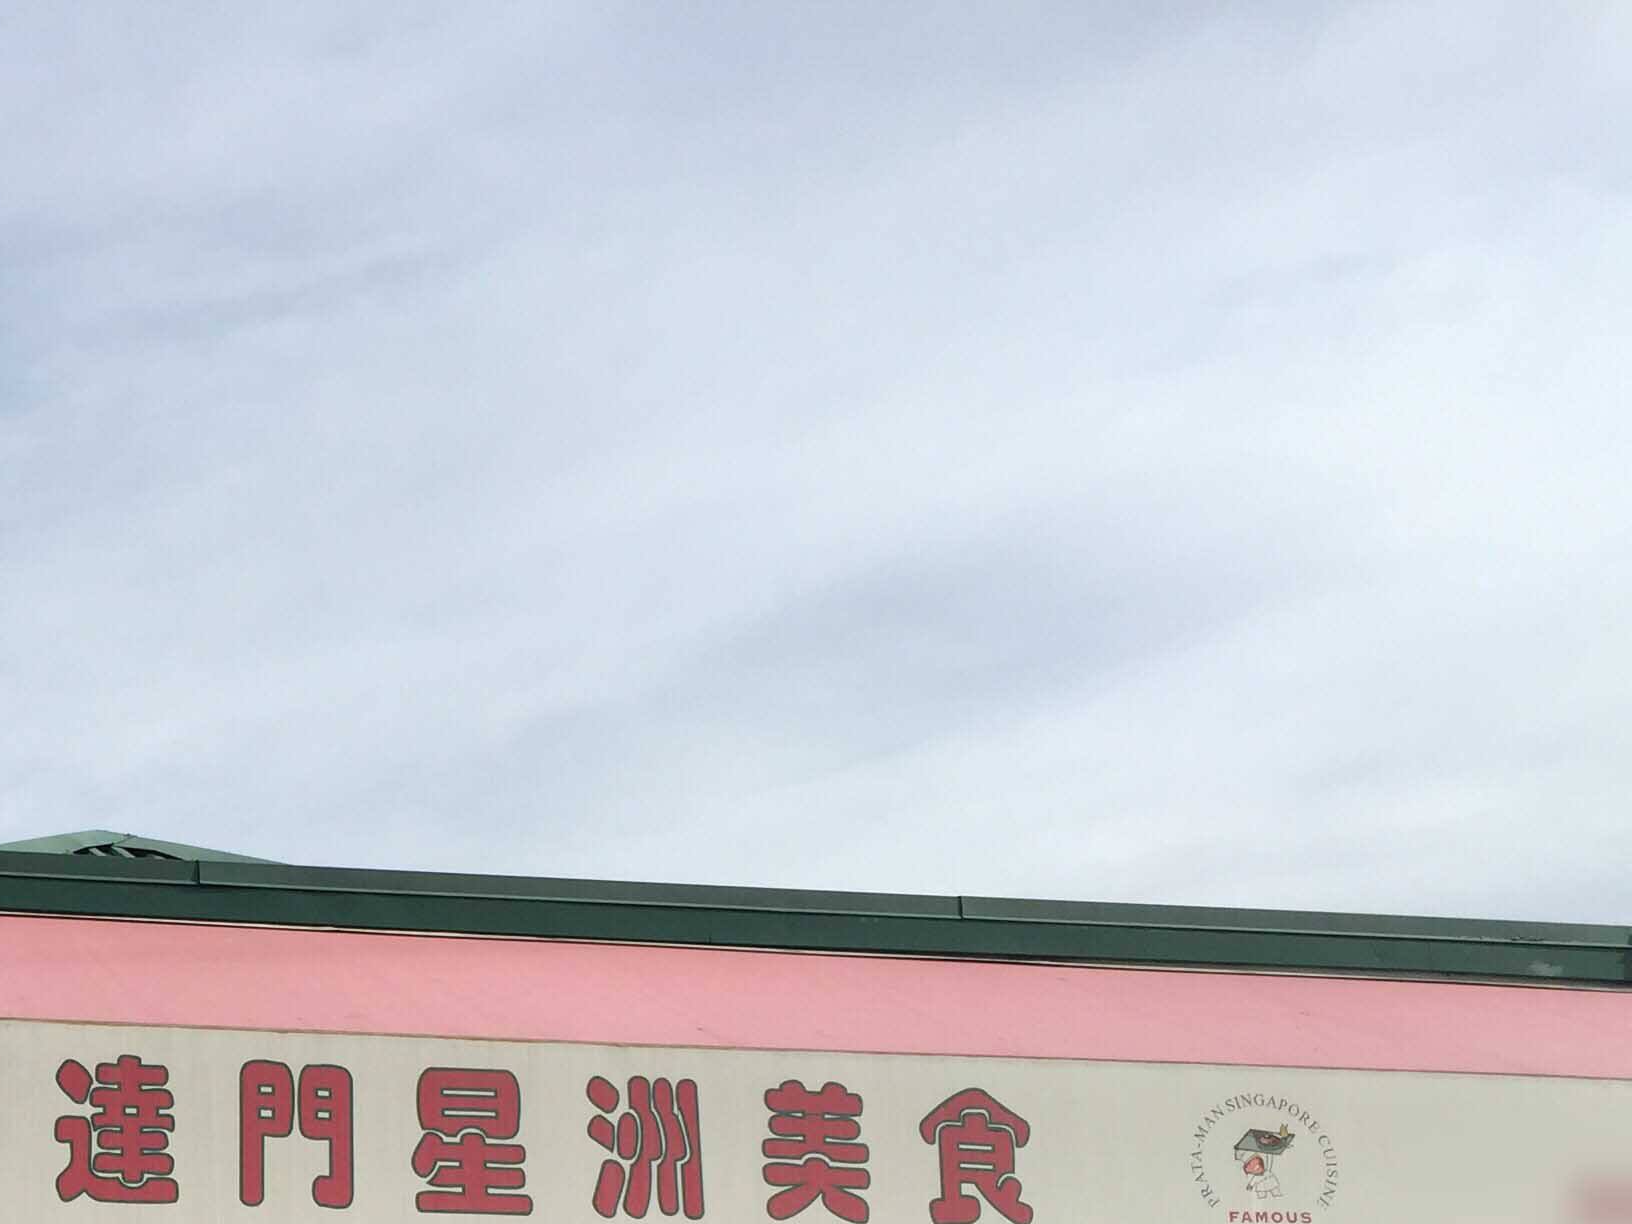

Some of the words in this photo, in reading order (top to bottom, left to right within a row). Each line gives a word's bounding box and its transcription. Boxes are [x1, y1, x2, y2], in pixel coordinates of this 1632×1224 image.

[1190, 1106, 1226, 1209] PRATA-MAN
[1224, 1093, 1322, 1135] SINGAPORE
[1228, 1210, 1313, 1224] FAMOUS
